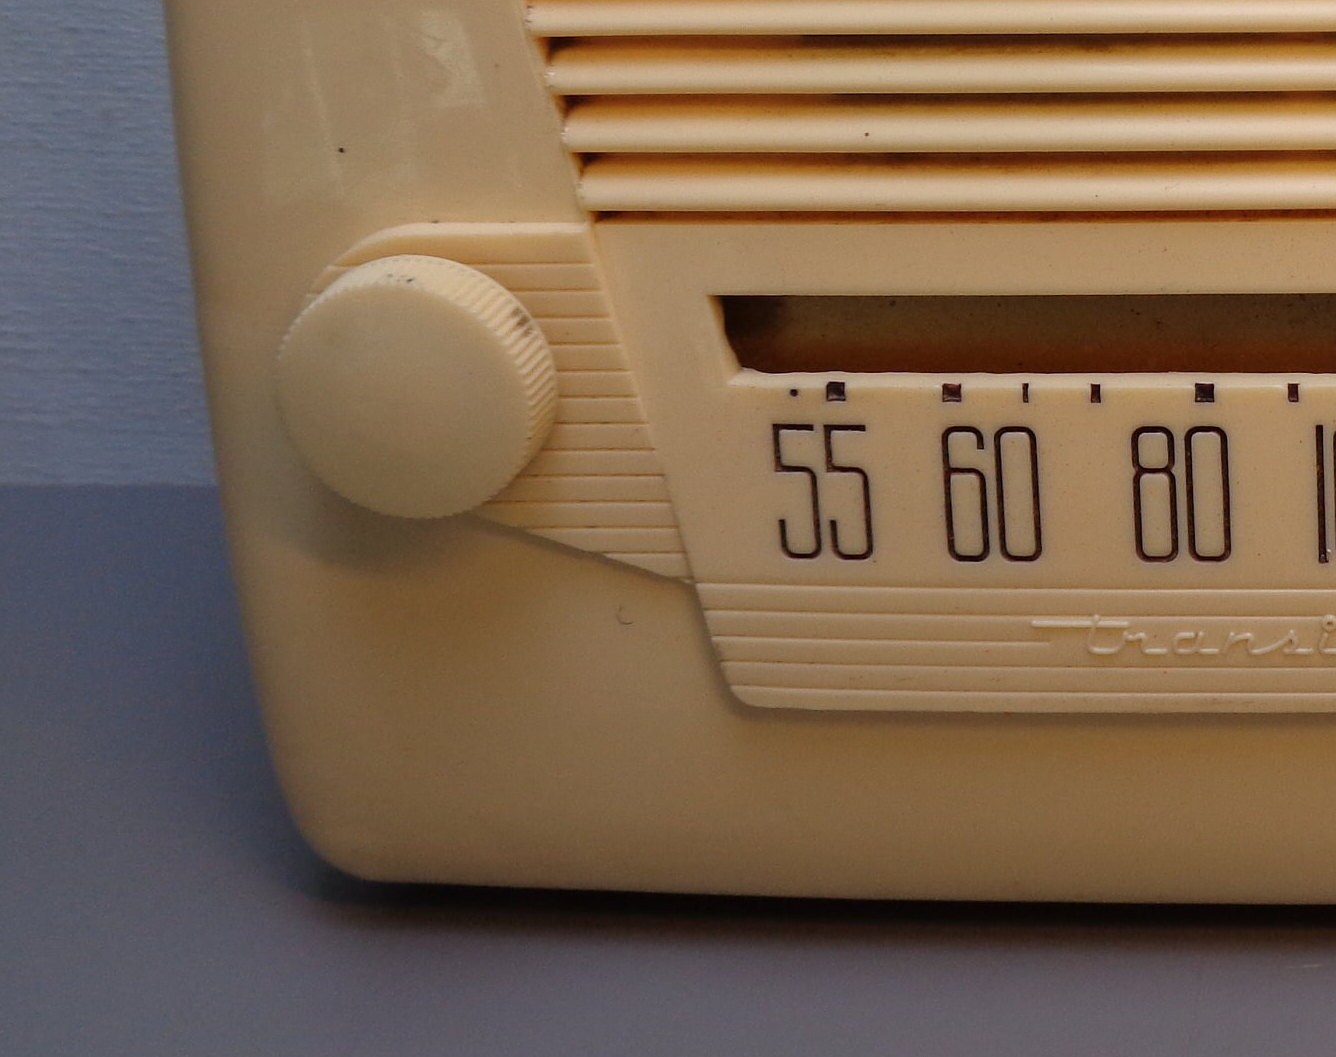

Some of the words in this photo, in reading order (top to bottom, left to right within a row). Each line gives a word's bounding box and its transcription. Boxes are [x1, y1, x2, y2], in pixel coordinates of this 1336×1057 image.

[772, 423, 873, 561] 55
[941, 425, 1041, 562] 60
[1131, 425, 1231, 562] 80
